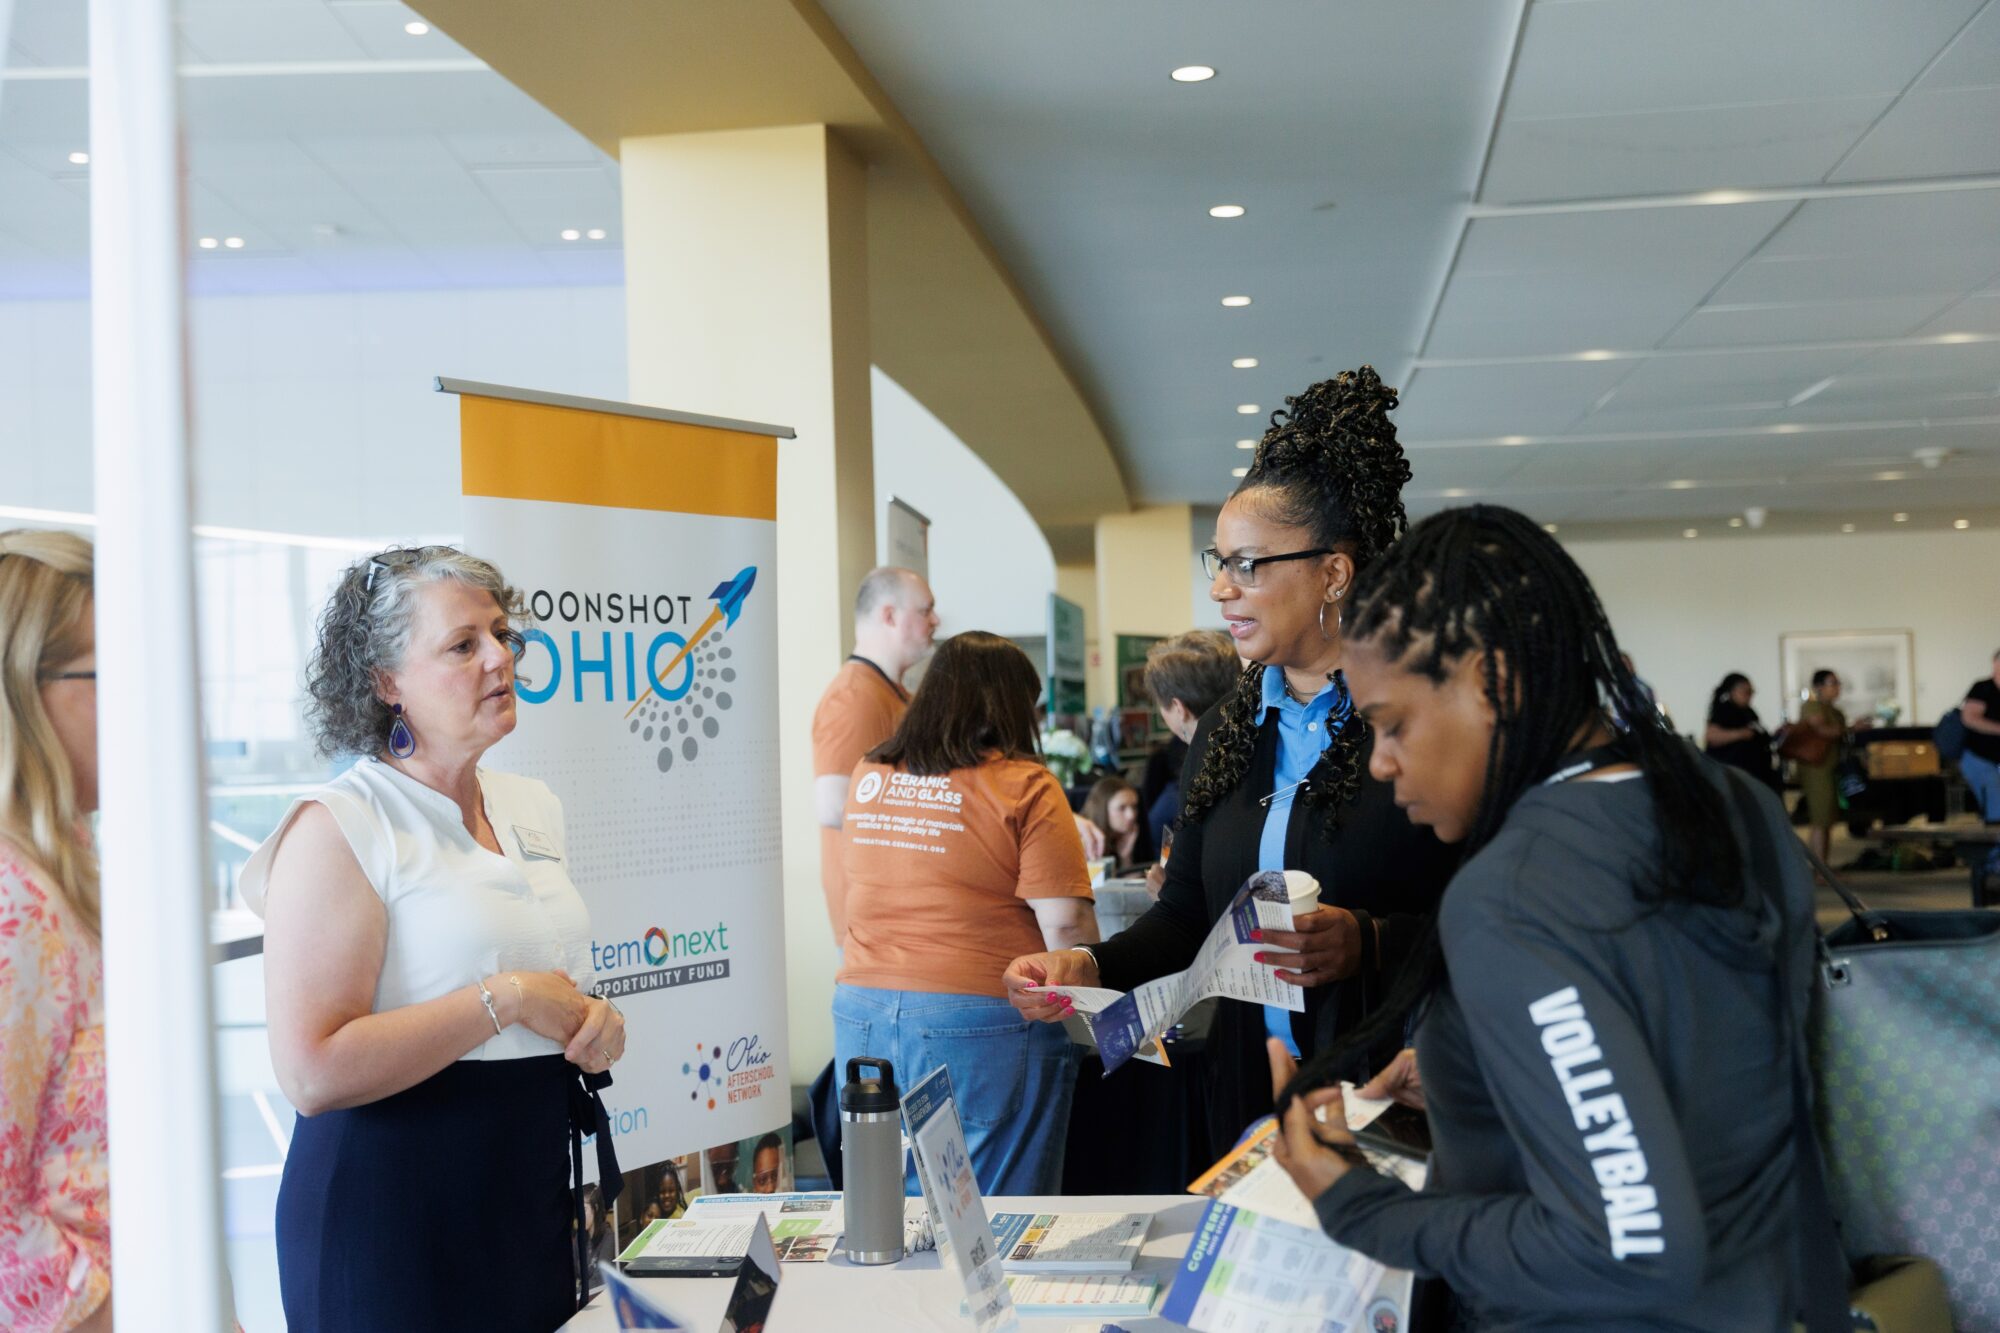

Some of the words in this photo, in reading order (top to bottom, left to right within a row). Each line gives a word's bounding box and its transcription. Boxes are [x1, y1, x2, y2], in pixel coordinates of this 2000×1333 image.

[520, 589, 692, 624] OONSHOT
[511, 628, 694, 704] OHIO
[886, 785, 917, 799] AND
[917, 788, 963, 806] GLASS
[891, 773, 950, 789] CERAMIC
[926, 819, 964, 831] materials
[591, 940, 640, 972] tem
[673, 921, 729, 958] next
[591, 969, 681, 996] PPORTUNITY
[688, 963, 725, 981] FUND
[727, 1034, 771, 1072] Ohio
[727, 1066, 775, 1088] AFTERSCHOOL
[728, 1084, 761, 1105] NETWORK
[1528, 985, 1665, 1261] VOLLEYBALL
